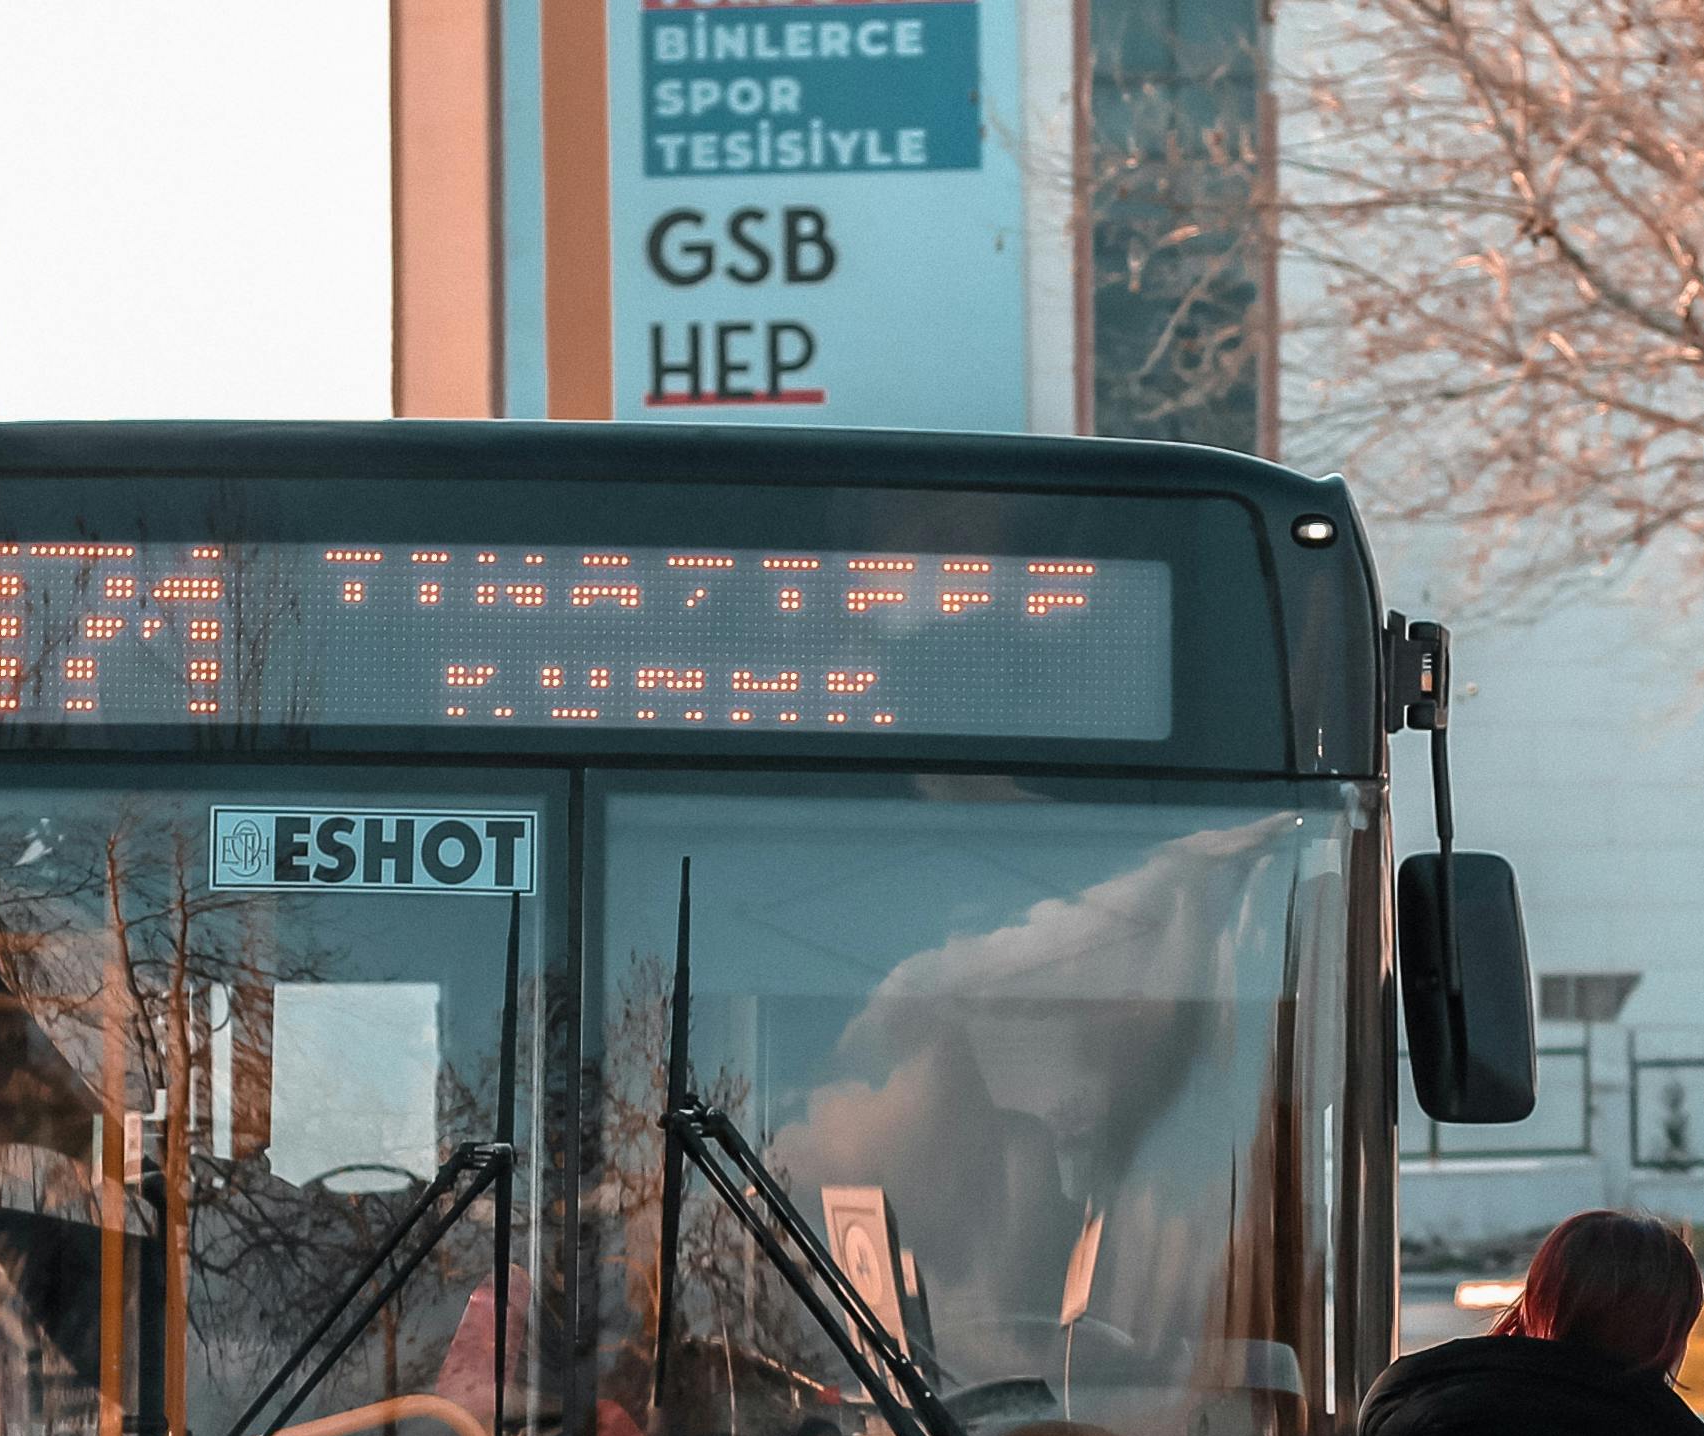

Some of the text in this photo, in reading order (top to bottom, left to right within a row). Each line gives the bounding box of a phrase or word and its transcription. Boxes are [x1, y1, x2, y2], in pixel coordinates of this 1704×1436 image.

[654, 12, 924, 61] BİNLERCE
[654, 77, 801, 116] SPOR
[655, 119, 927, 170] TESİSİYLE
[646, 207, 837, 287] GSB
[649, 322, 816, 400] HEP
[274, 815, 525, 887] ESHOT
